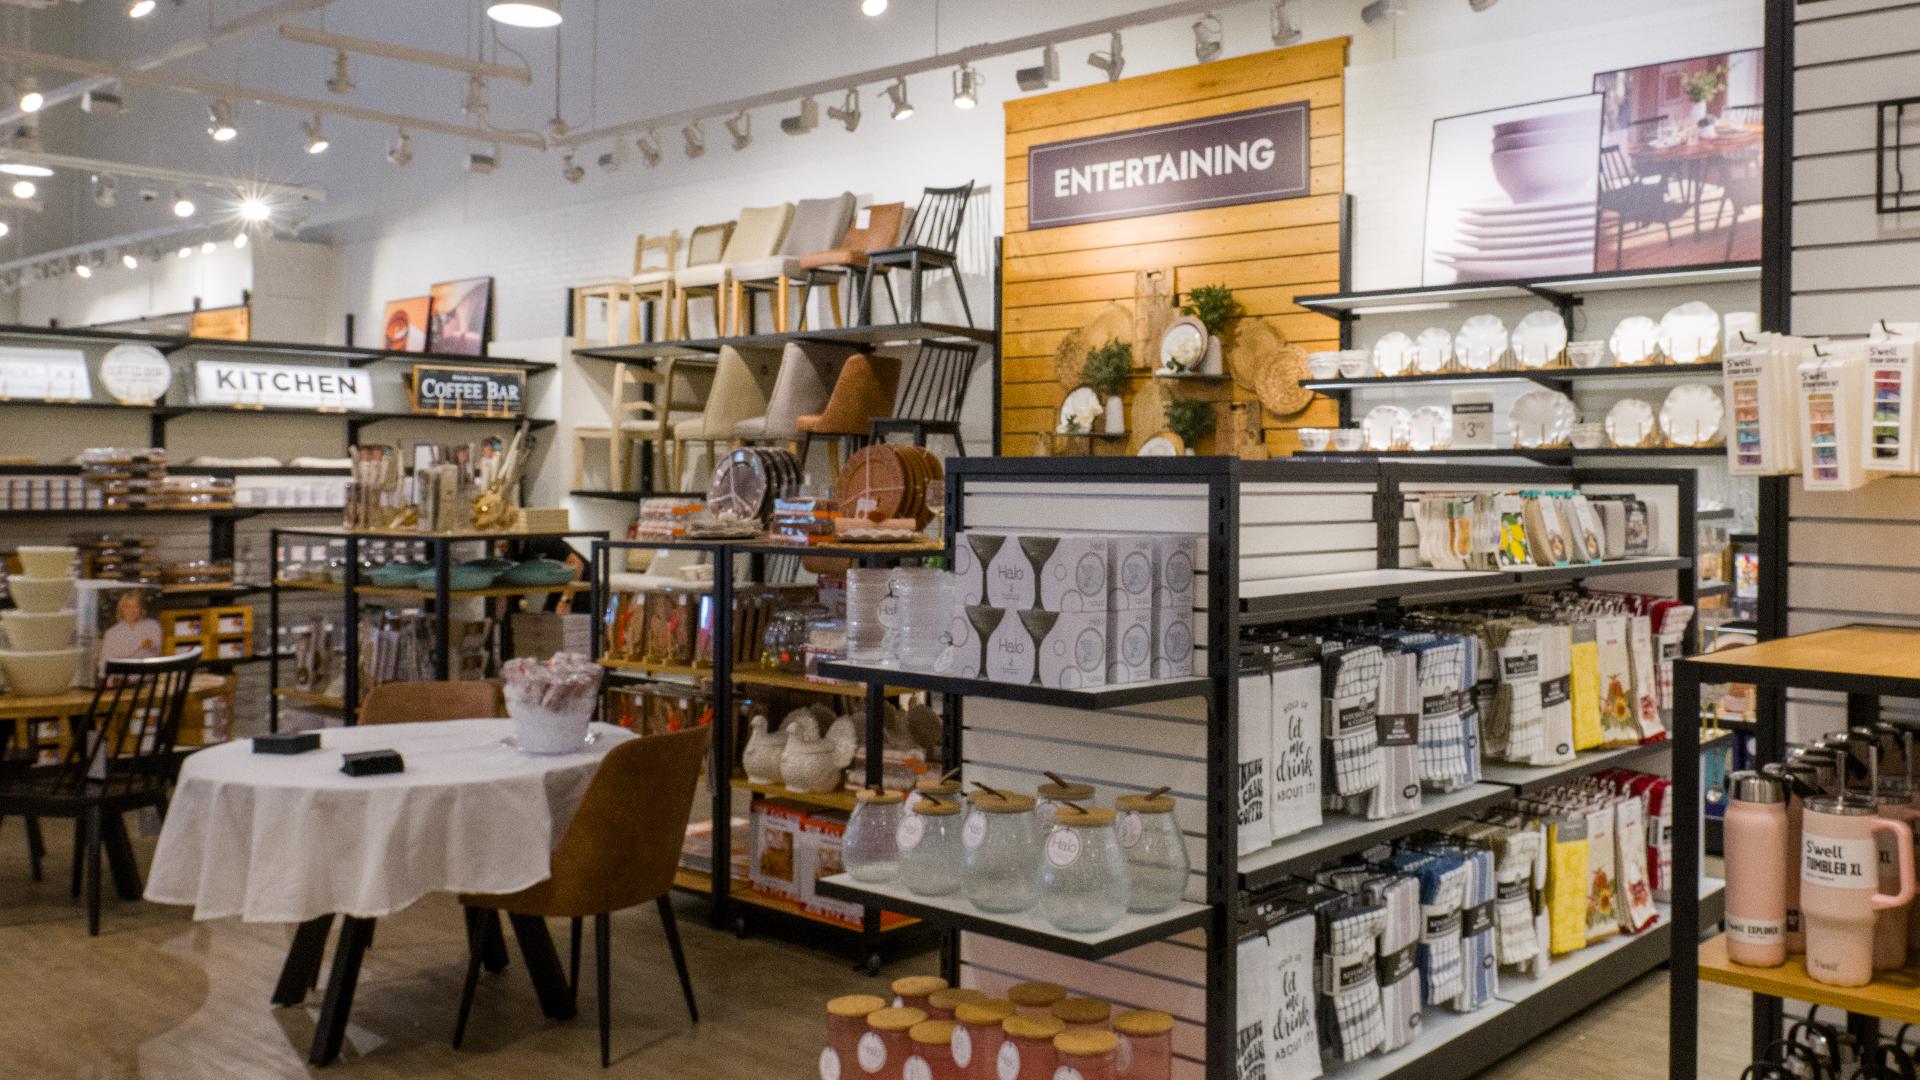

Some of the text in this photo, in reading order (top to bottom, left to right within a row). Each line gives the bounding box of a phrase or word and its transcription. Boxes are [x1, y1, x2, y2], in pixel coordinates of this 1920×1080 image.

[1054, 138, 1276, 198] ENTERTAINING
[216, 369, 358, 394] KITCHEN
[421, 378, 520, 401] COFFEE BAR
[998, 564, 1024, 580] Halo
[998, 638, 1024, 654] Halo
[1276, 746, 1313, 782] drink
[1806, 856, 1847, 876] TUMBLER
[1850, 863, 1862, 877] XL
